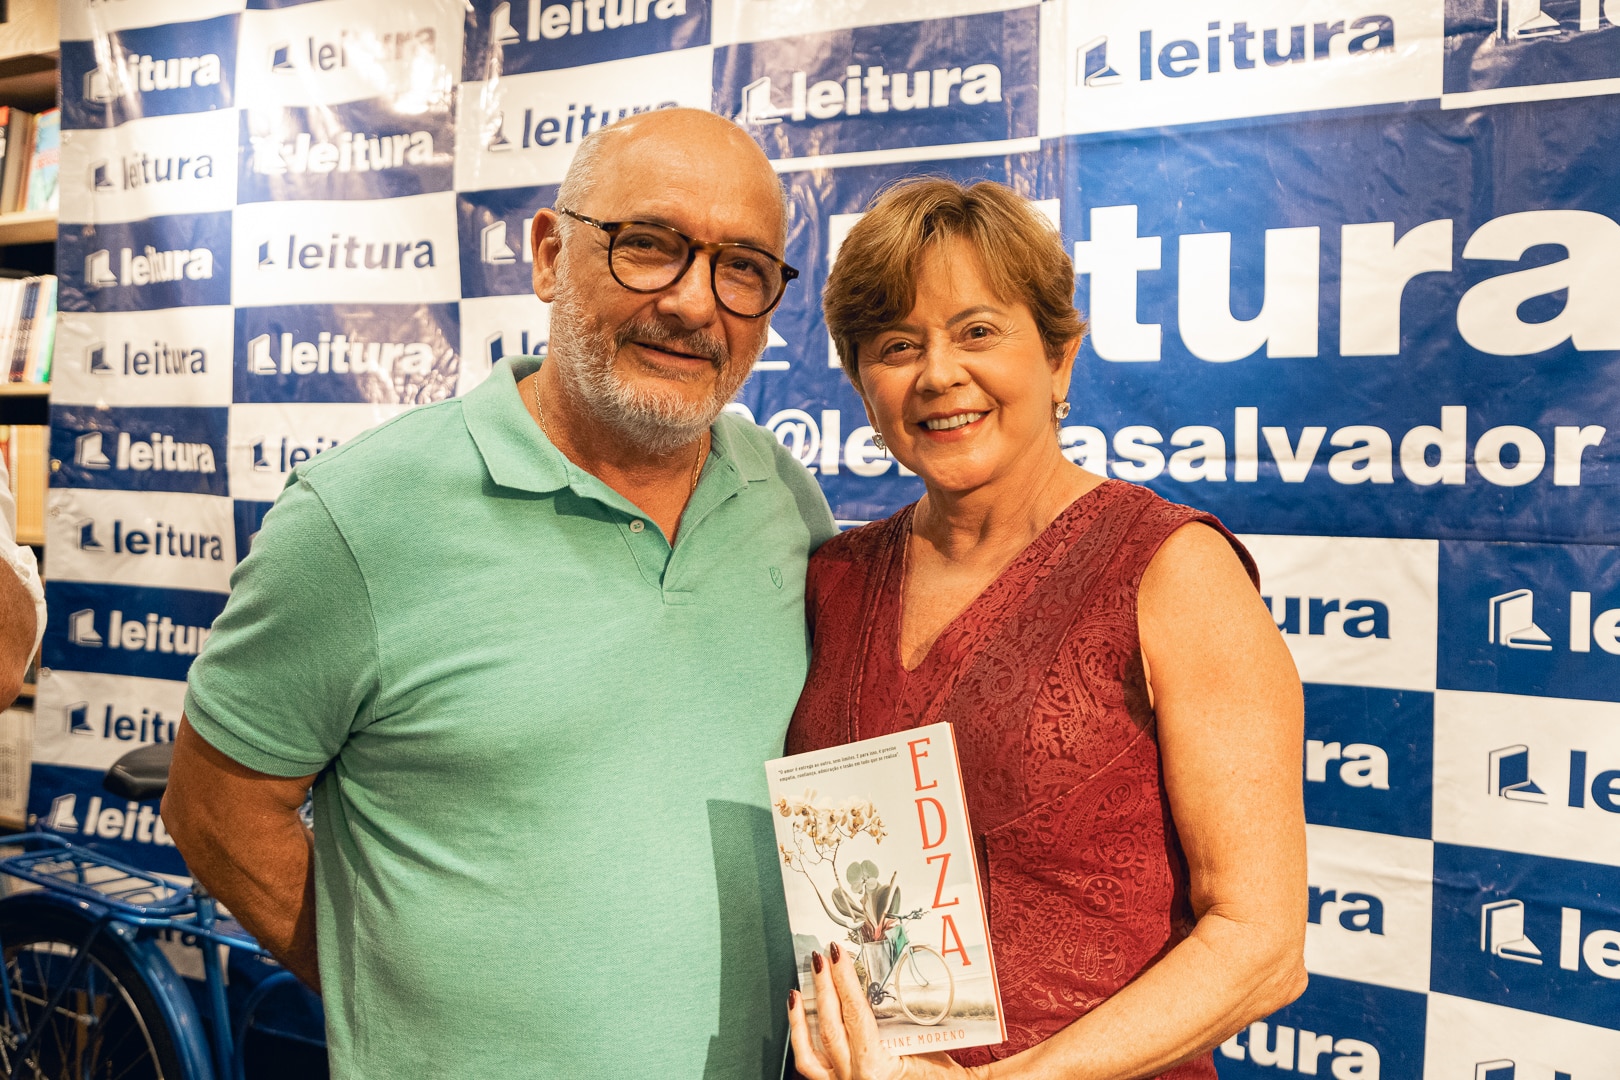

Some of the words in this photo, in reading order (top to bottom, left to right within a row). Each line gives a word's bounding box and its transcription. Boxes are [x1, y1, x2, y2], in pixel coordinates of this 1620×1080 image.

[527, 0, 687, 42] leitura
[1139, 14, 1396, 82] leitura
[792, 63, 1002, 121] leitura
[123, 154, 213, 190] leitura
[296, 131, 434, 173] leitura
[120, 246, 213, 285] leitura
[287, 233, 435, 270] leitura
[123, 341, 207, 376] leitura
[281, 332, 434, 375] leitura
[116, 432, 216, 474] leitura
[113, 521, 223, 561] leitura
[907, 737, 972, 967] EDZA
[918, 1030, 966, 1045] MORENO
